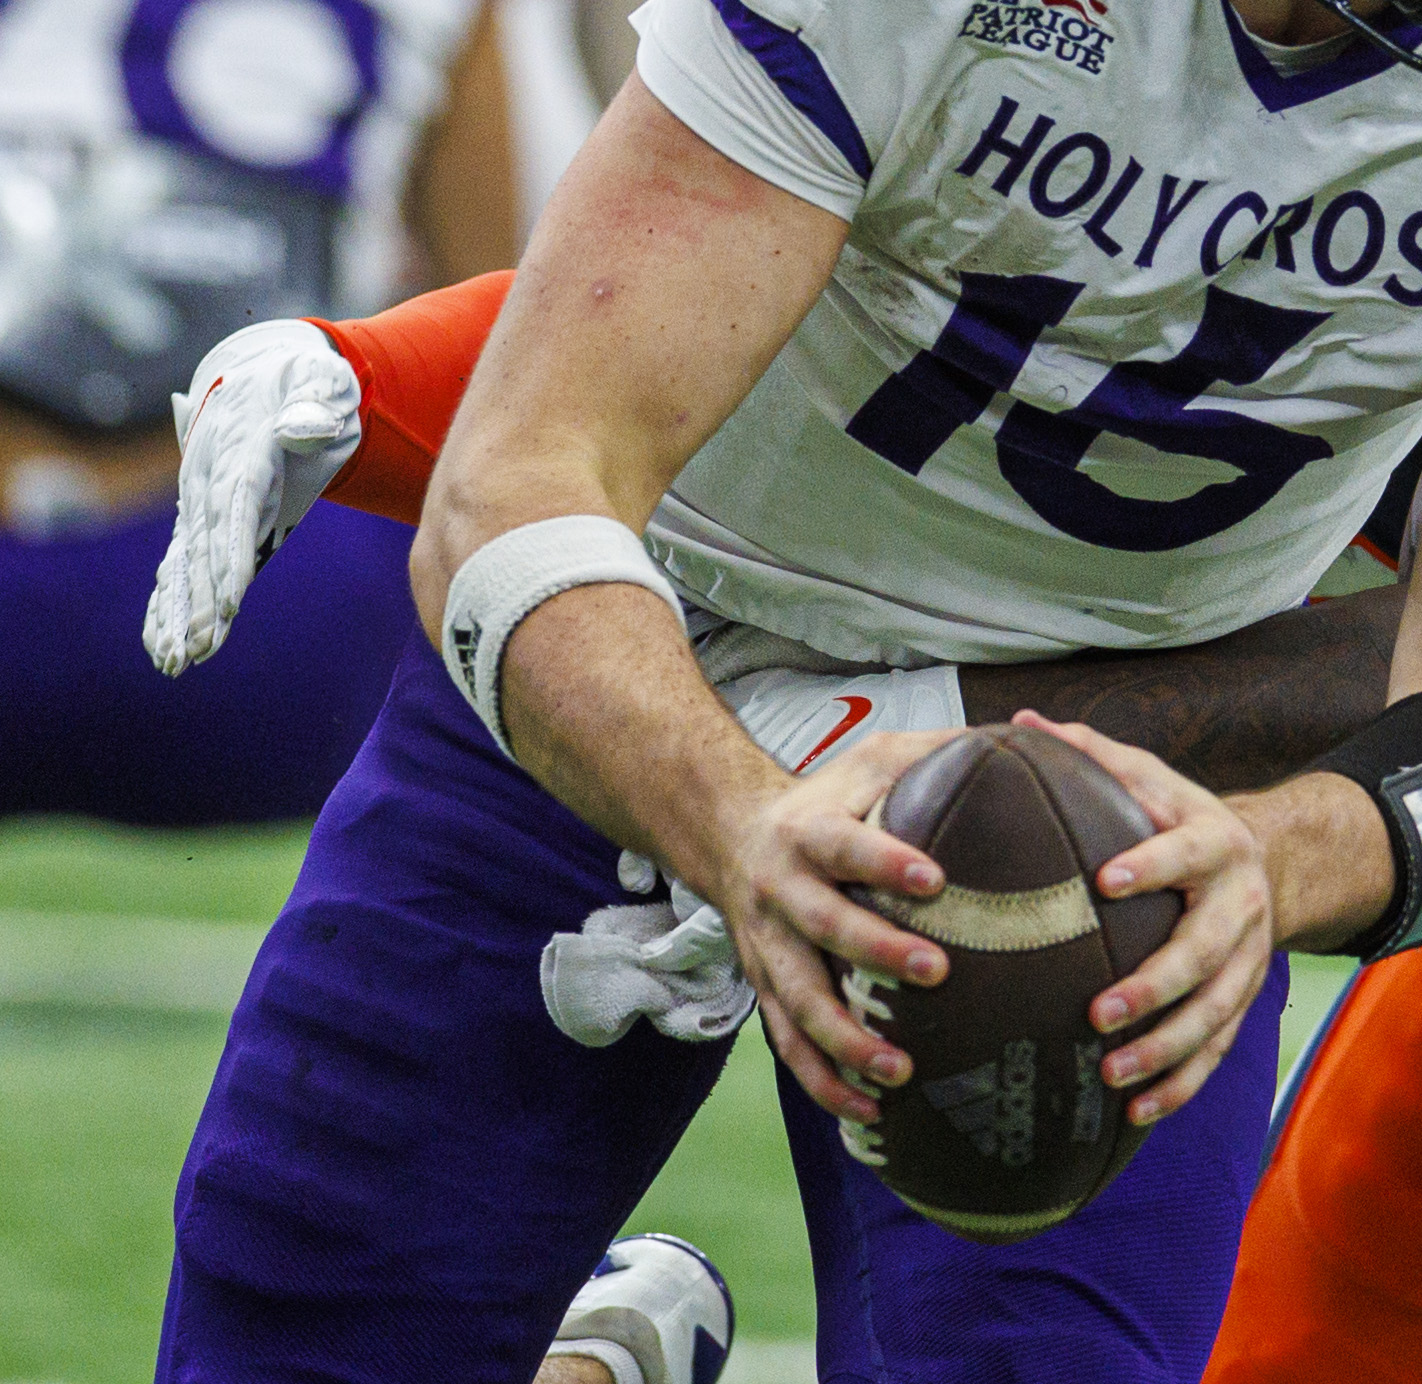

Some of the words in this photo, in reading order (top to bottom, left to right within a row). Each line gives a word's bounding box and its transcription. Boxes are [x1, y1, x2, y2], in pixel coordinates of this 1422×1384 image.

[957, 18, 1106, 76] LEAGUE
[963, 3, 1114, 54] PATRIOT
[954, 95, 1208, 269] HOLY
[845, 271, 1335, 553] 16
